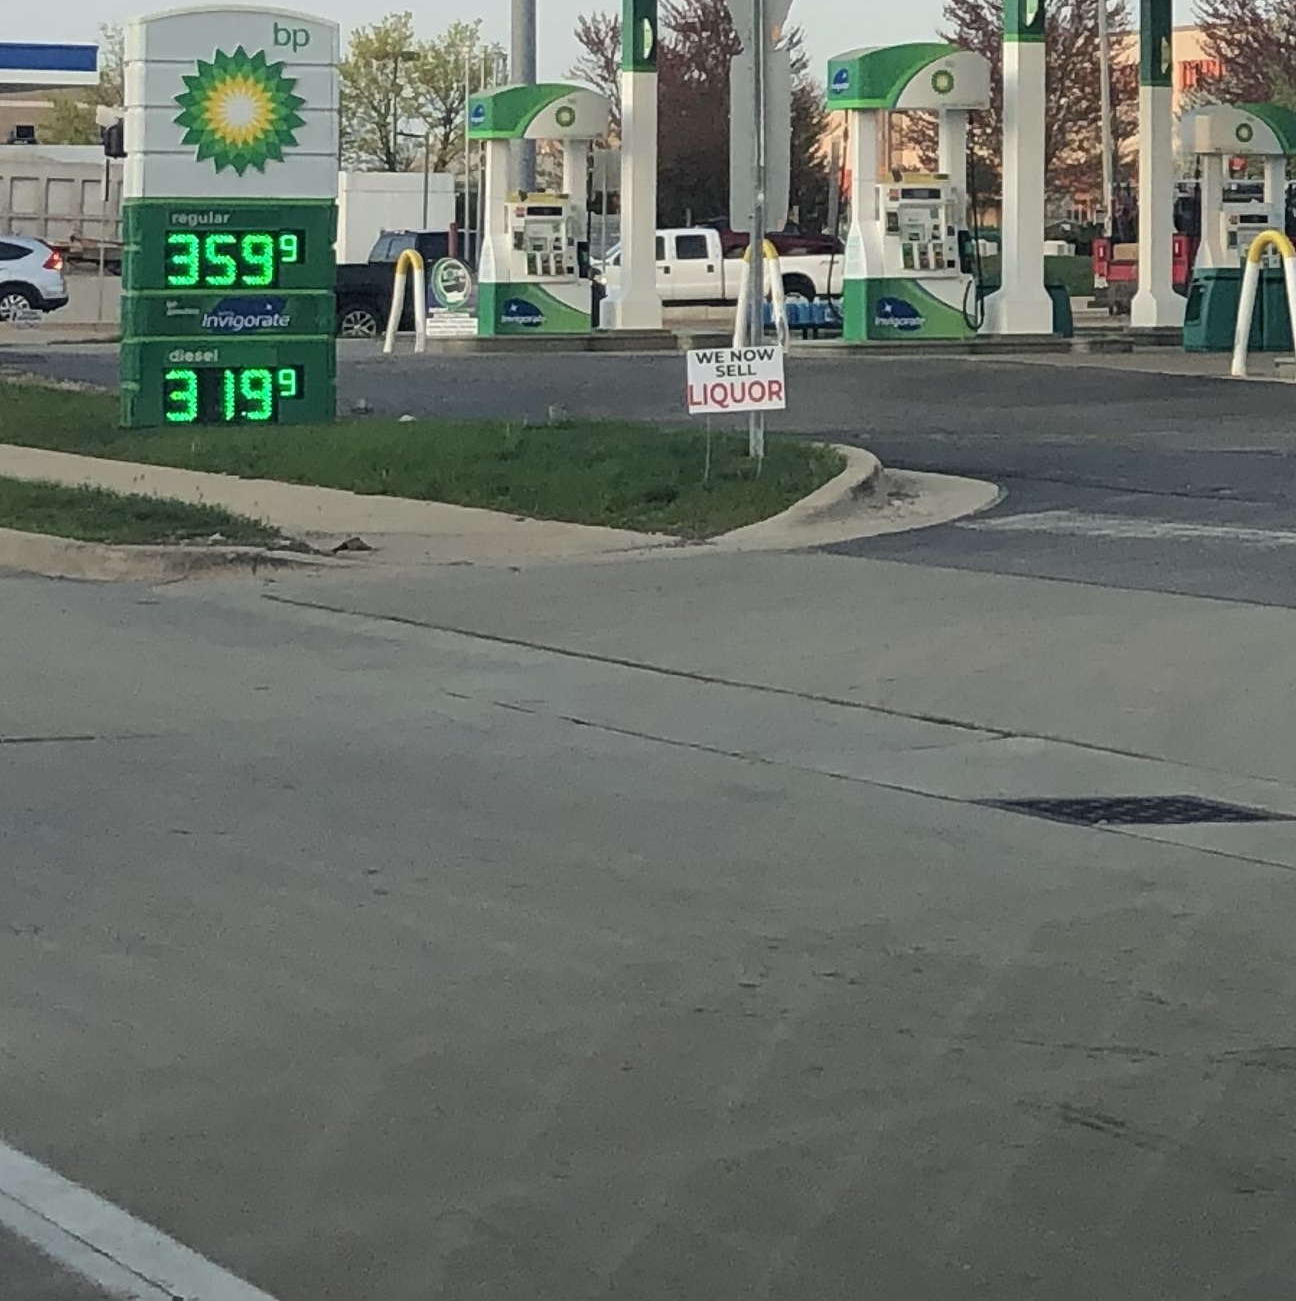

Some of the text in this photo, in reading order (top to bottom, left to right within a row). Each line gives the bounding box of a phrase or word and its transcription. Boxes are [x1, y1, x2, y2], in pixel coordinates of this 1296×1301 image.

[273, 22, 310, 53] bp
[171, 211, 230, 227] regular
[202, 313, 290, 331] Invigorate
[168, 350, 218, 363] diesel
[695, 348, 775, 364] WE NOW
[715, 364, 757, 378] SELL
[688, 380, 782, 408] LIQUOR
